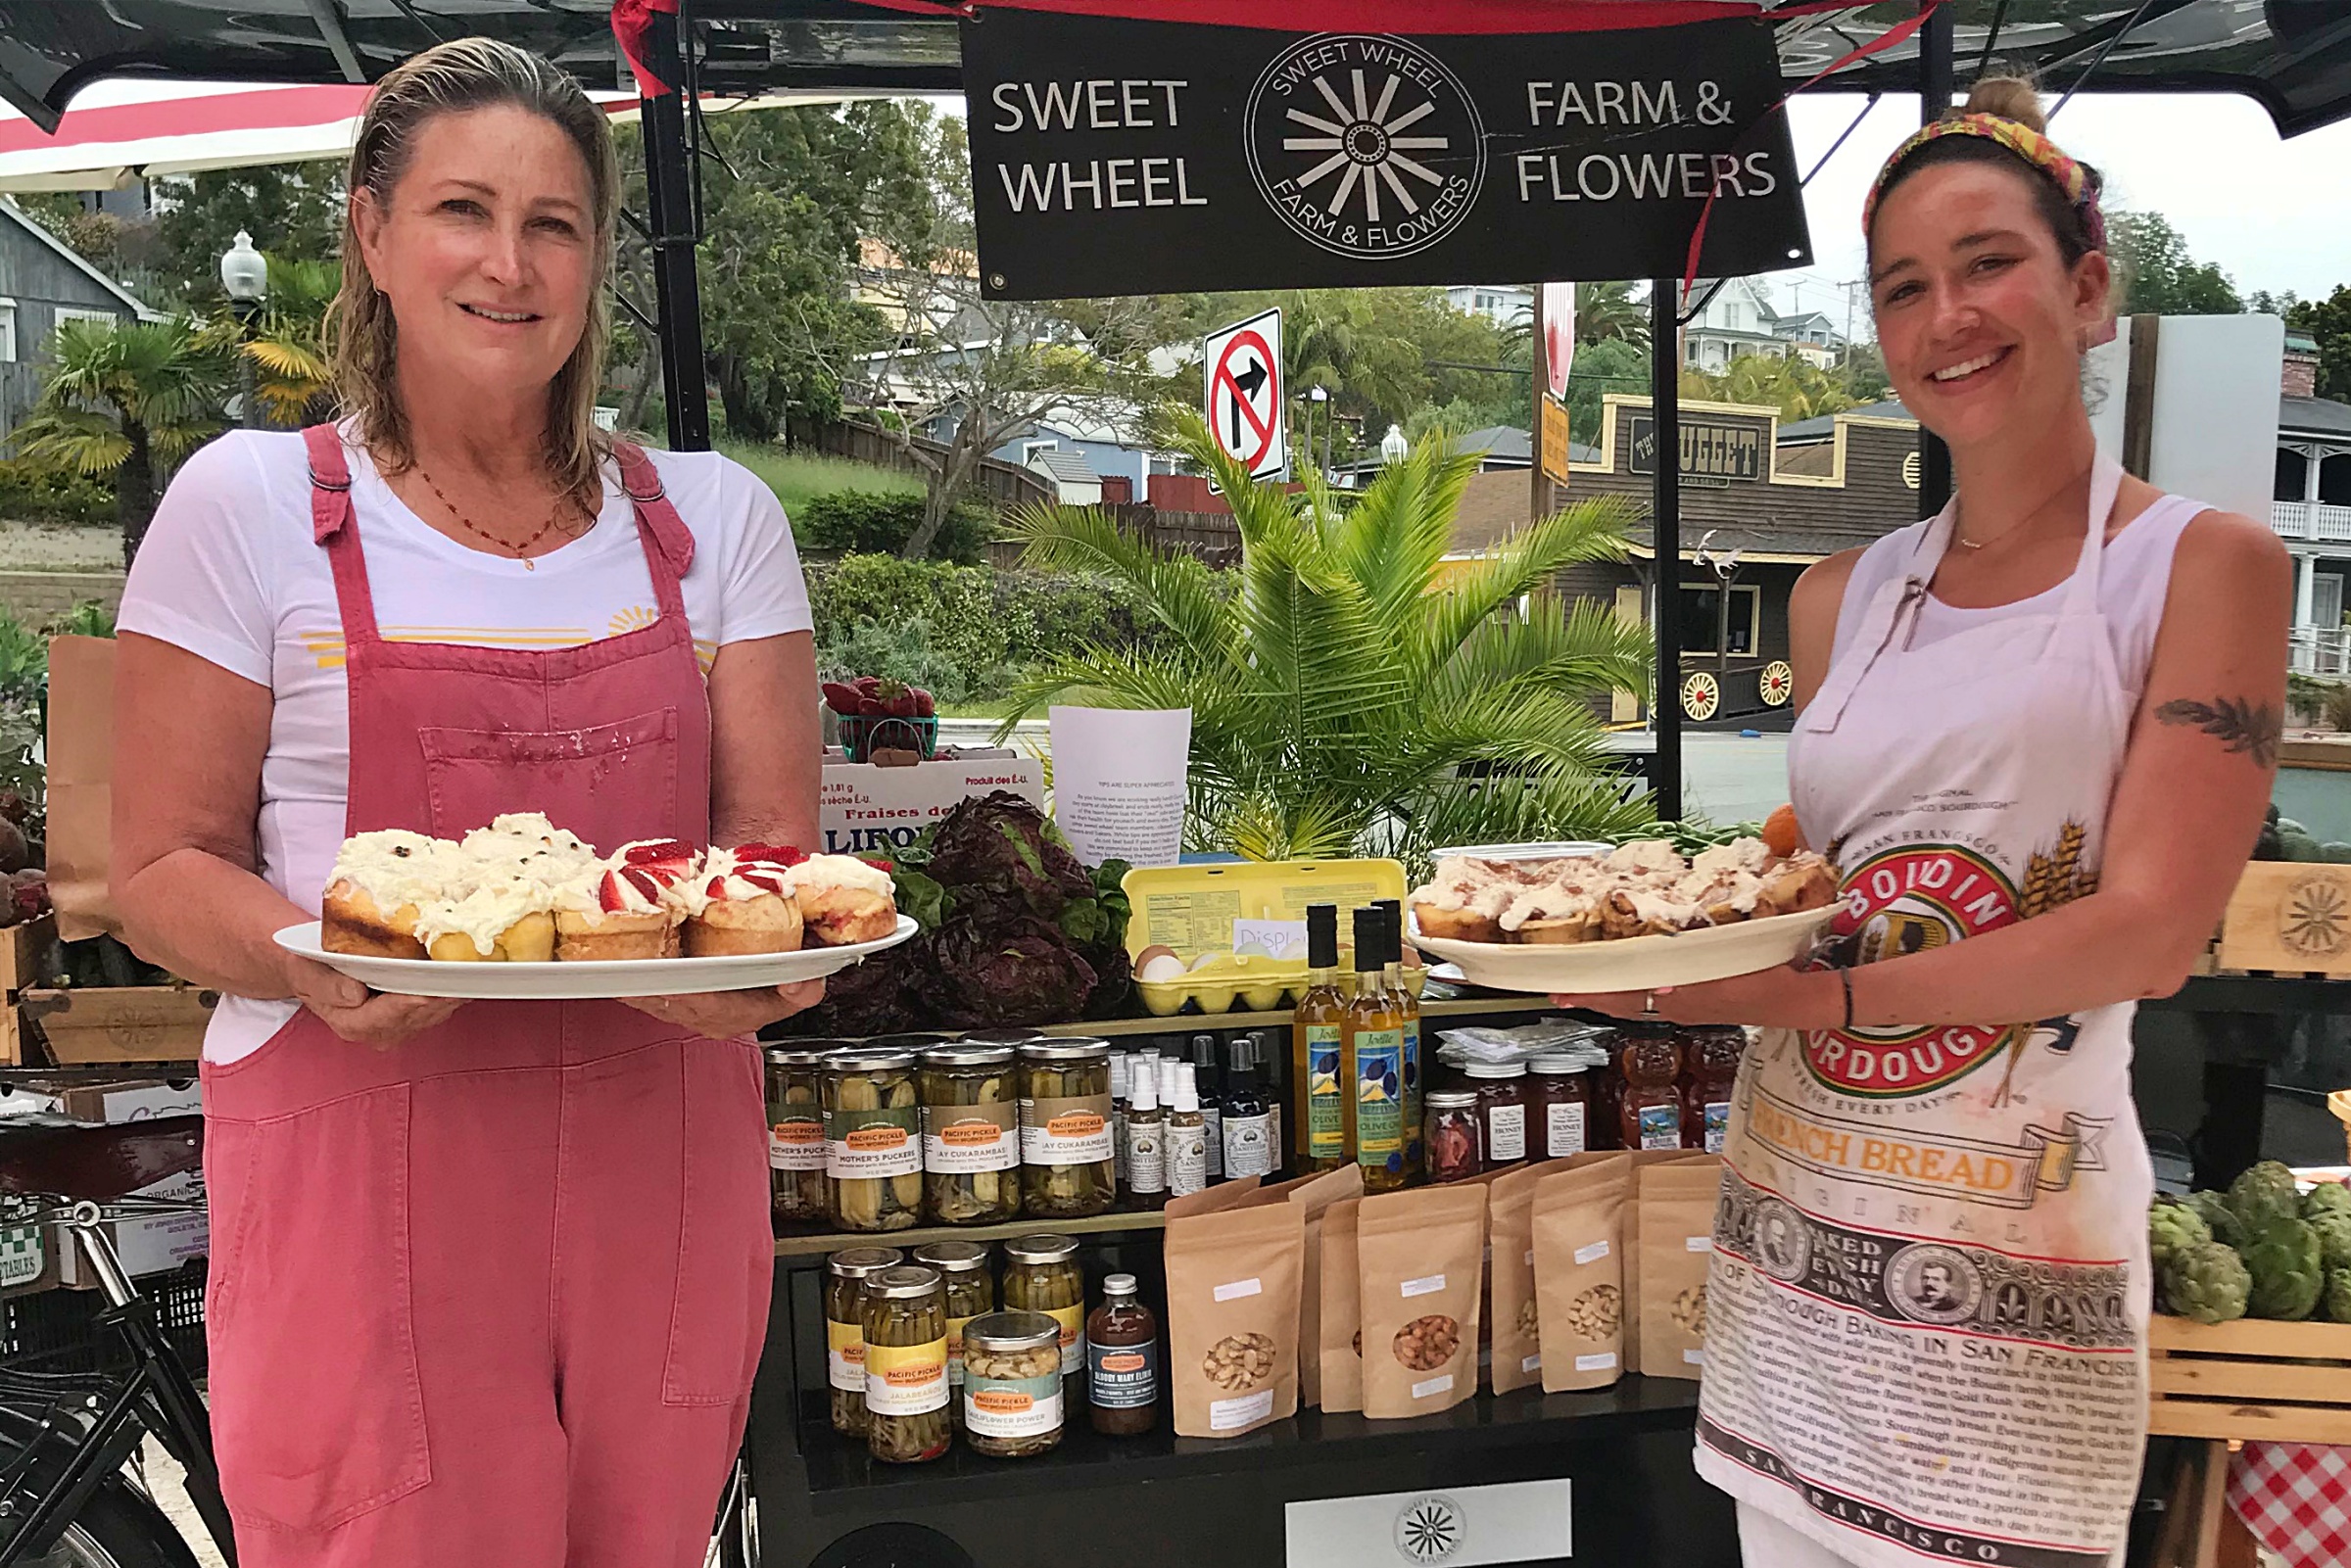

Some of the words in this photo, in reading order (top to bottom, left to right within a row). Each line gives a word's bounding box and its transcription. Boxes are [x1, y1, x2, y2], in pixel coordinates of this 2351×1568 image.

[1272, 42, 1349, 96] SWEET
[1360, 42, 1443, 99] WHEEL
[992, 80, 1188, 132] SWEET
[1527, 80, 1680, 125] FARM
[1696, 80, 1735, 125] &
[997, 158, 1208, 213] WHEEL
[1517, 152, 1776, 202] FLOWERS
[1273, 178, 1337, 237] FARM
[1341, 225, 1359, 246] &
[1367, 174, 1468, 247] FLOWERS
[1635, 432, 1654, 460] TH
[1678, 425, 1756, 476] UGGET
[966, 777, 993, 785] Produit
[995, 776, 1011, 784] des
[845, 808, 919, 820] Fraises
[825, 826, 922, 855] LIFO
[1862, 834, 1895, 853] SAN
[1807, 1023, 1995, 1082] URDOUG
[972, 1127, 997, 1136] PICKLE
[1752, 1098, 1852, 1167] FRENCH
[1861, 1138, 2015, 1192] BREAD
[840, 1155, 880, 1164] MOTHER'S
[882, 1150, 915, 1161] PUCKERS
[1724, 1263, 1746, 1282] OF
[1846, 1315, 1915, 1350] BAKING
[1924, 1337, 1948, 1354] IN
[1961, 1339, 2014, 1364] SAN
[888, 1369, 915, 1379] PACIFIC
[919, 1365, 940, 1376] PICKLE
[1094, 1371, 1116, 1383] BLOODY
[1117, 1373, 1135, 1383] MARY
[1135, 1369, 1152, 1381] ELIXIR
[967, 1409, 1014, 1424] CAULIFLOWER
[1017, 1413, 1045, 1424] POWER
[976, 1394, 1000, 1403] PACIFIC
[1885, 1418, 1949, 1443] Sourdough
[1810, 1491, 2000, 1561] RANCISCO
